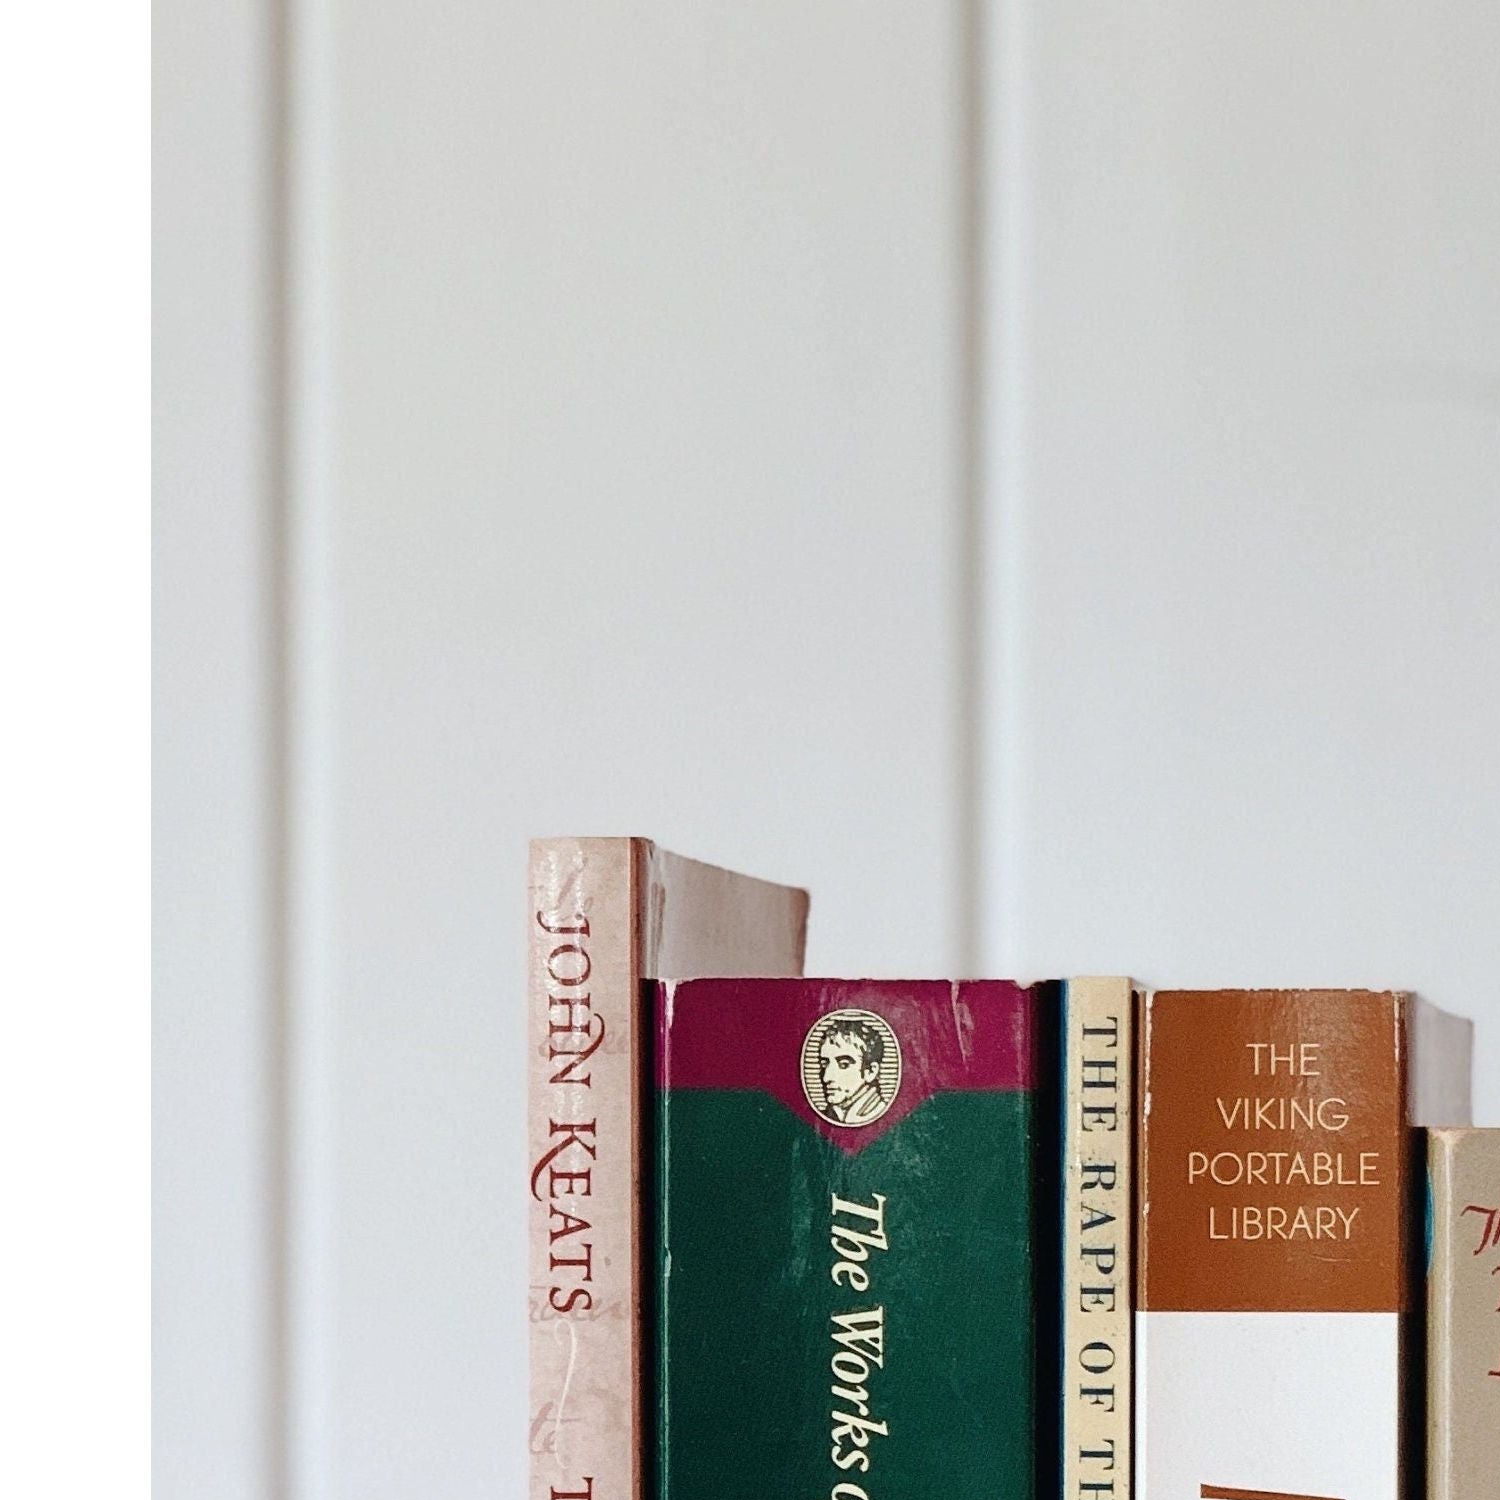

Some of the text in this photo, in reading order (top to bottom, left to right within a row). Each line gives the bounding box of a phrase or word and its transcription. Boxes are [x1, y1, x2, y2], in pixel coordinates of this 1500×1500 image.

[537, 911, 604, 1088] JOHN
[1081, 1016, 1118, 1133] THE
[1246, 1042, 1321, 1077] THE
[1215, 1097, 1350, 1132] VIKING
[530, 1116, 597, 1313] KEATS
[1187, 1152, 1381, 1187] PORTABLE
[830, 1193, 889, 1291] The
[1080, 1160, 1118, 1314] RAPE
[1207, 1206, 1360, 1241] LIBRARY
[830, 1306, 888, 1472] Works
[1078, 1341, 1117, 1413] OF
